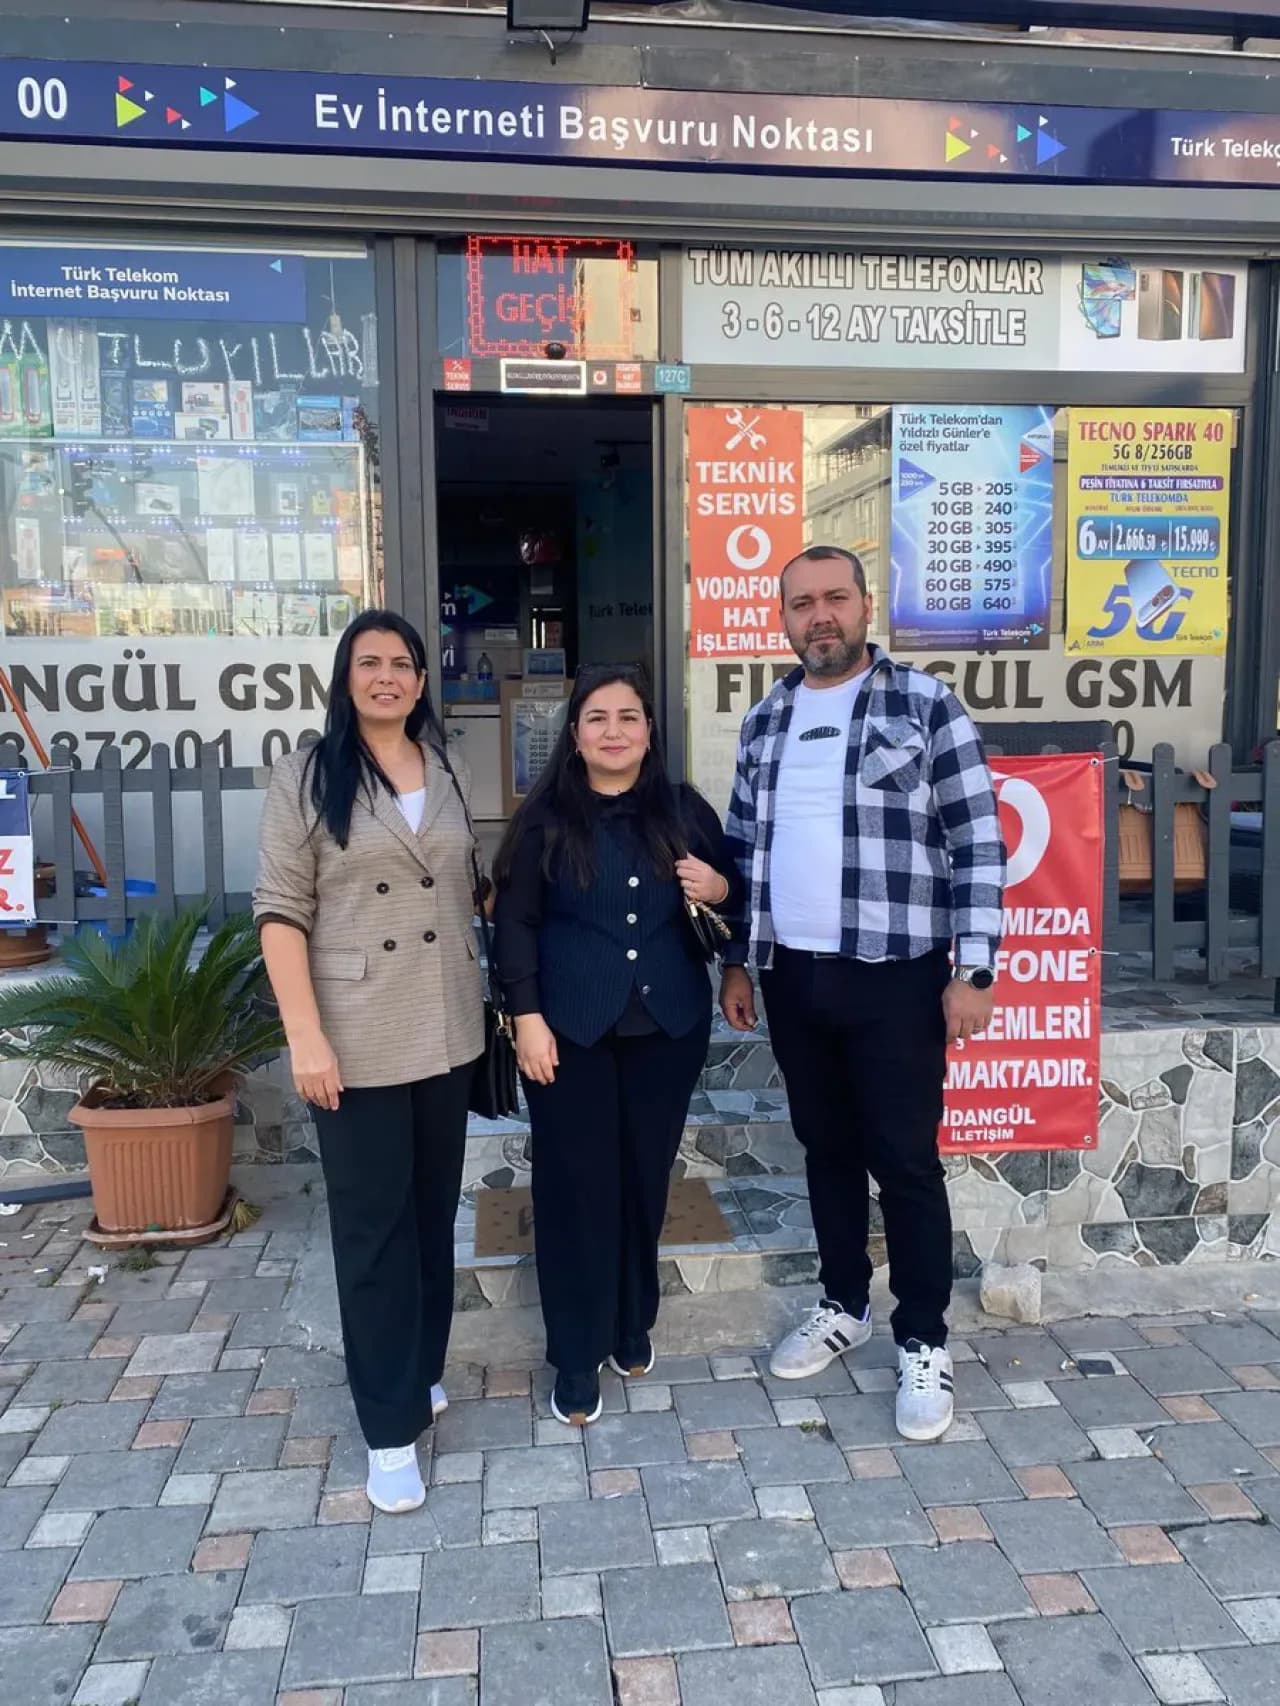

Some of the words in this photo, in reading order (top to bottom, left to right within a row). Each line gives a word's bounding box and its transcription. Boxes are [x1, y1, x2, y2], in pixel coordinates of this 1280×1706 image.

[314, 93, 363, 131] Ev
[378, 87, 546, 140] İnterneti
[559, 103, 719, 155] Başvuru
[733, 114, 873, 153] Noktası
[1171, 136, 1216, 157] Türk
[513, 244, 568, 274] HAT
[688, 244, 753, 287] TÜM
[760, 252, 854, 289] AKILLI
[861, 254, 1043, 294] TELEFONLAR
[61, 265, 102, 283] Türk
[105, 267, 179, 285] Telekom
[11, 279, 82, 300] İnternet
[87, 283, 159, 302] Başvuru
[164, 285, 230, 303] Noktası
[846, 304, 885, 342] AY
[890, 300, 1027, 347] TAKSİTLE
[899, 413, 926, 425] Türk
[930, 413, 1003, 426] Telekom'dan
[899, 427, 939, 439] Yıldızlı
[942, 427, 990, 439] Günler'e
[1078, 421, 1136, 441] TECNO
[1143, 422, 1197, 442] SPARK
[1204, 422, 1224, 442] 40
[899, 440, 923, 452] özel
[926, 440, 970, 454] fiyatlar
[1113, 444, 1130, 460] 5G
[1135, 444, 1193, 462] 8/256GB
[695, 456, 796, 484] TEKNİK
[939, 483, 948, 495] 5
[951, 483, 973, 495] GB
[985, 483, 1012, 495] 205
[696, 487, 797, 516] SERVİS
[931, 502, 948, 515] 10
[951, 502, 973, 515] GB
[985, 502, 1012, 515] 240
[928, 522, 948, 534] 20
[951, 522, 973, 534] GB
[985, 522, 1012, 534] 305
[1079, 519, 1097, 555] 6
[1098, 539, 1110, 551] AY
[927, 541, 947, 554] 30
[950, 541, 972, 554] GB
[984, 541, 1011, 554] 395
[926, 560, 947, 573] 40
[950, 560, 972, 573] GB
[984, 560, 1011, 573] 490
[1172, 567, 1219, 579] TECNO
[696, 575, 781, 600] VODAFO
[925, 579, 947, 592] 60
[949, 579, 971, 592] GB
[983, 579, 1010, 592] 575
[926, 597, 947, 610] 80
[949, 597, 971, 610] GB
[983, 597, 1010, 610] 640
[723, 607, 771, 628] HAT
[1066, 658, 1193, 709] GSM
[943, 1058, 1093, 1090] MAKTADIR.
[951, 1126, 1014, 1143] İLETİŞİM
